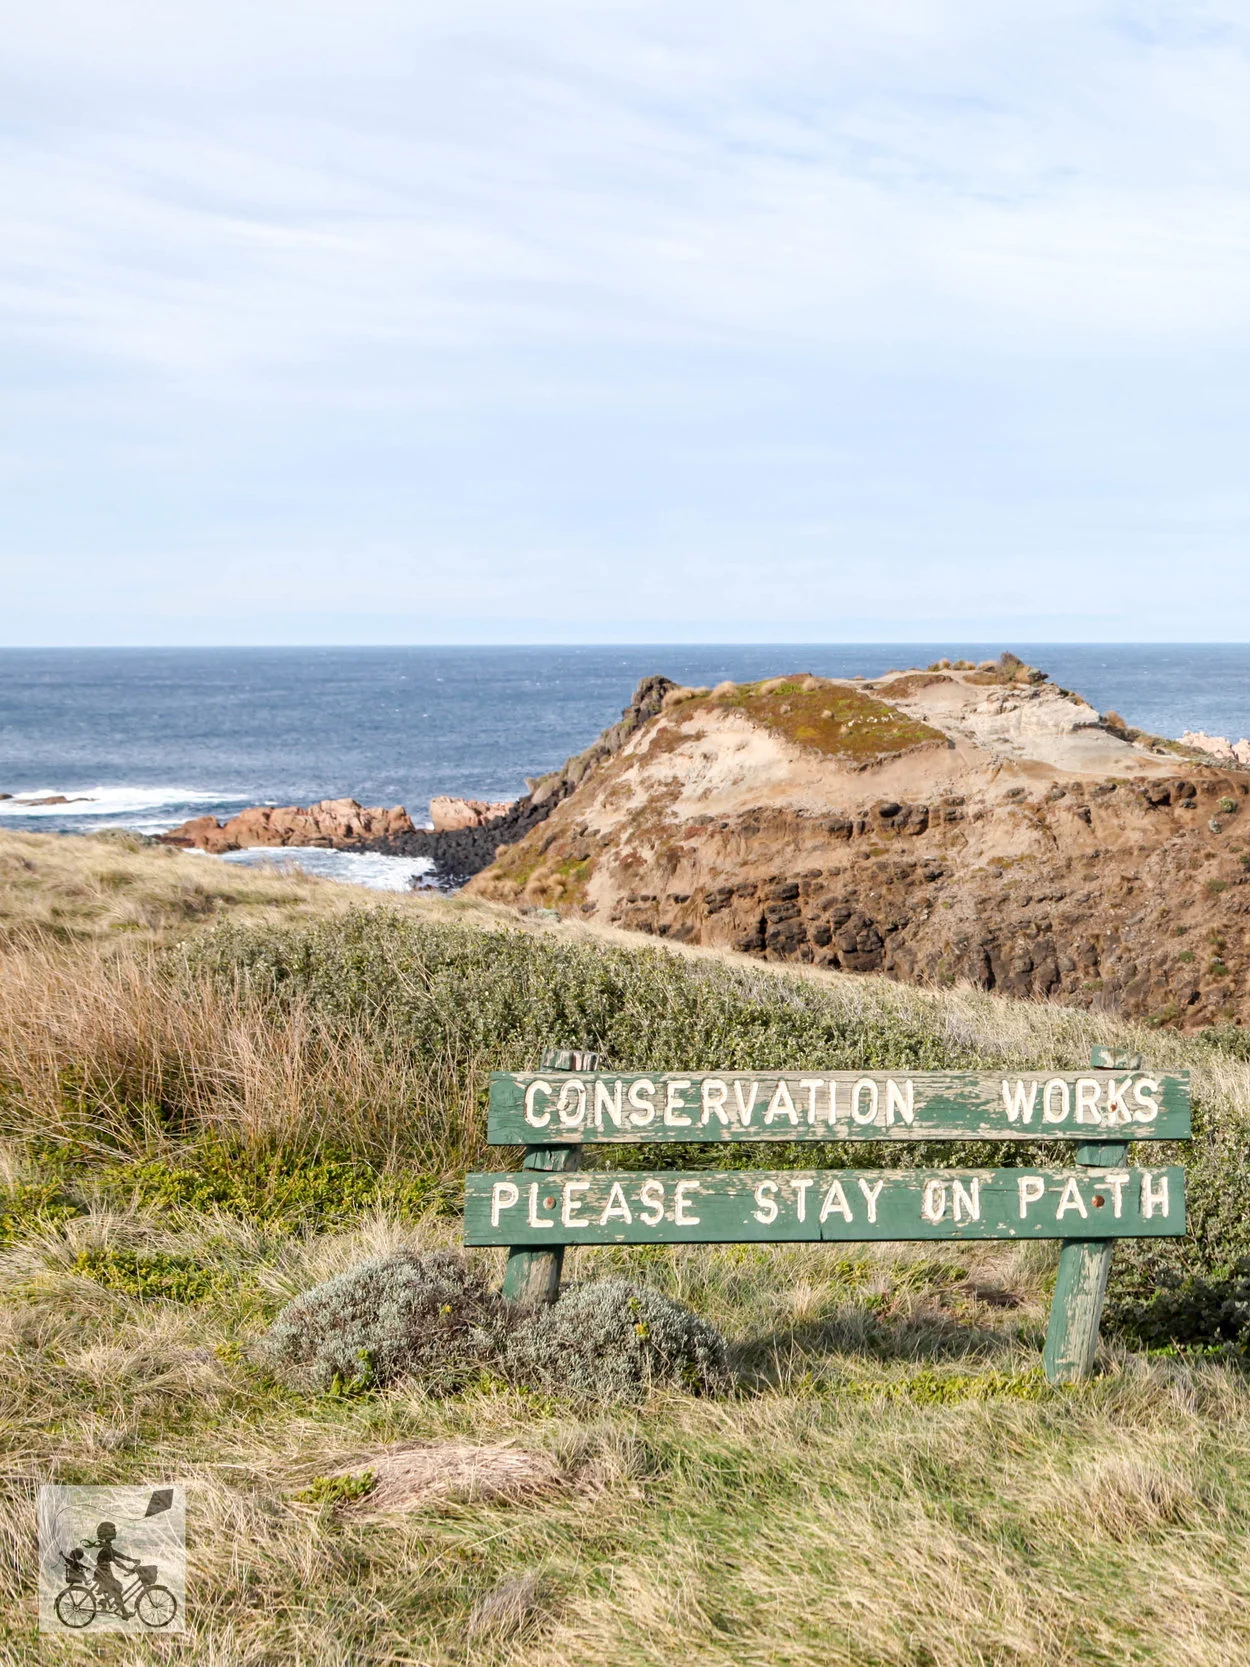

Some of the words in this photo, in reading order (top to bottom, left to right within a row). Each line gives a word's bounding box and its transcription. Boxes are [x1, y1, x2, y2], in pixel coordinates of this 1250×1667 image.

[524, 1078, 915, 1128] CONSERVATION
[1001, 1077, 1159, 1125] WORKS
[491, 1180, 701, 1228] PLEASE
[754, 1179, 884, 1224] STAY
[921, 1178, 980, 1223] ON
[1017, 1172, 1169, 1220] PATH
